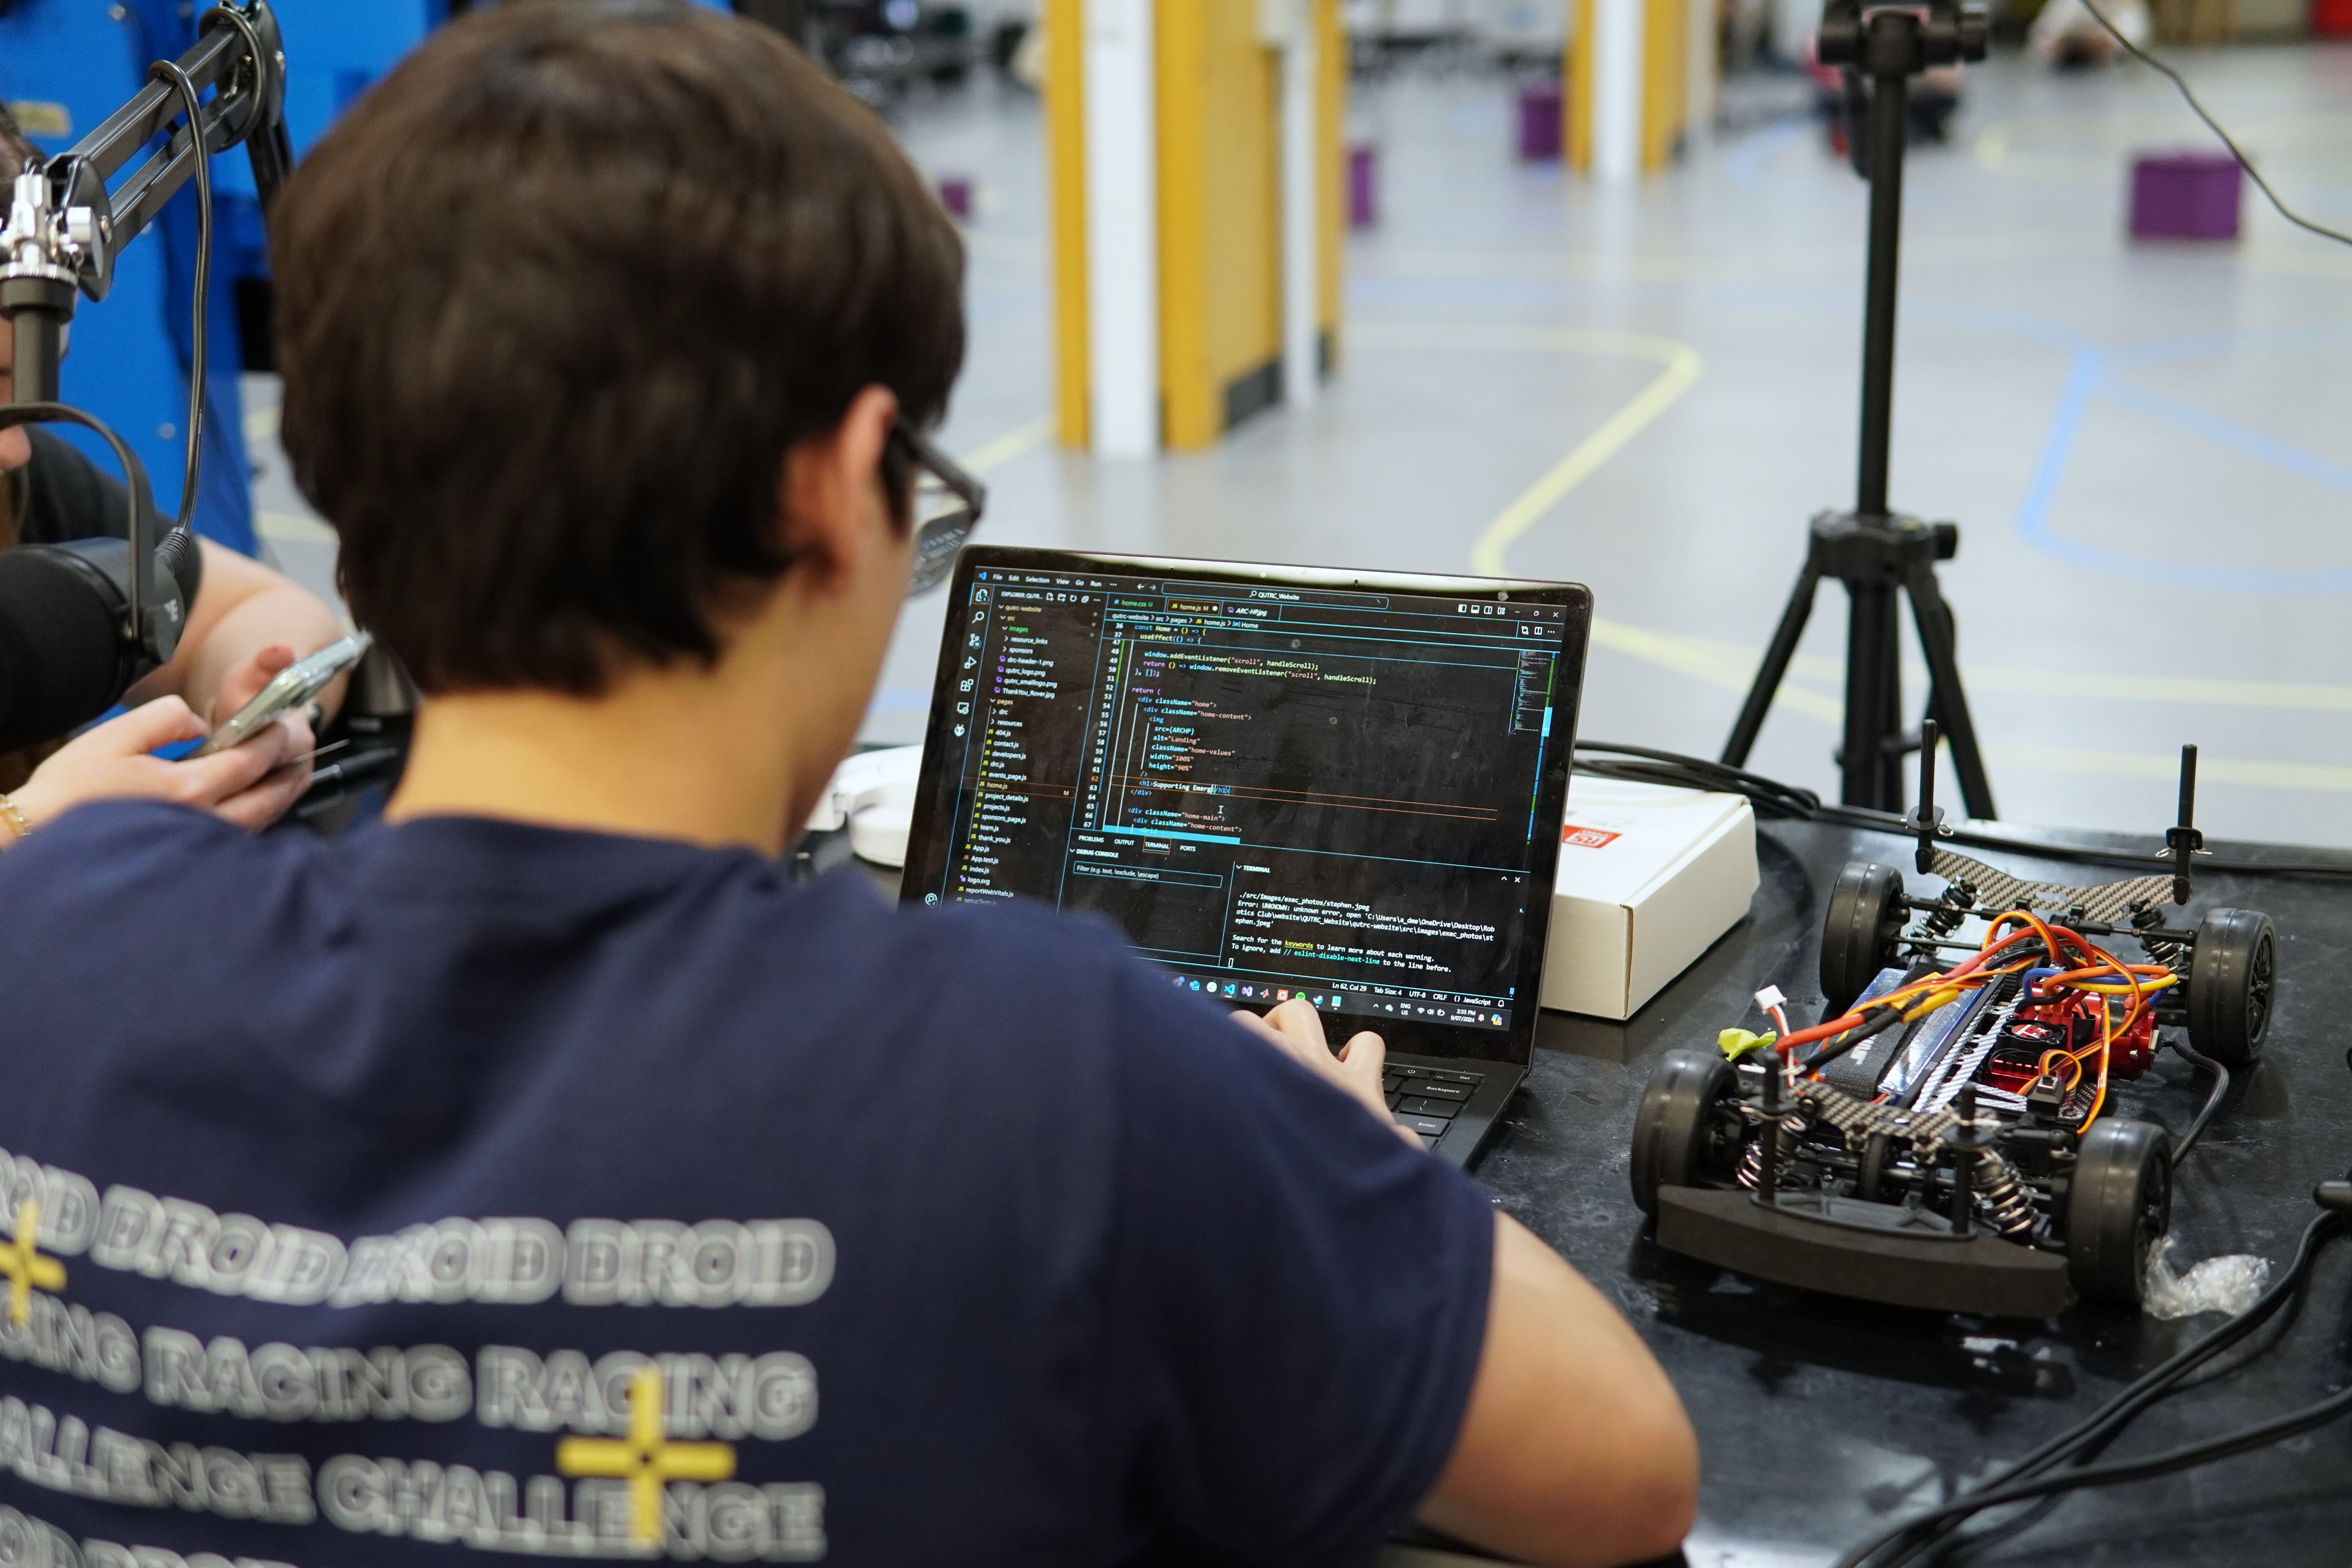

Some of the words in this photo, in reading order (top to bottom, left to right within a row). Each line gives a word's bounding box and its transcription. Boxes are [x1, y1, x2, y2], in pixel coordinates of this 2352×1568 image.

[1258, 592, 1299, 600] QUTRC_Website
[1180, 604, 1201, 612] home.js
[1236, 608, 1267, 617] ARC-HP.jpg
[1007, 657, 1054, 667] drc-header-1.png
[1267, 660, 1318, 670] handleScroll);
[1005, 668, 1045, 677] qutrc_logo.png
[1004, 678, 1057, 688] qutrc_smalllogo.png
[1324, 674, 1376, 684] handleScroll);
[1003, 688, 1055, 699] ThankYou_Rover.jpg
[1154, 726, 1194, 735] src={ARCHP}
[992, 751, 1026, 760] developers.js
[988, 772, 1027, 781] events_page.js
[987, 782, 1007, 790] home.js
[1139, 780, 1190, 791] <h1>Supporting
[1131, 787, 1152, 795] </div>
[985, 793, 1028, 803] project_details.js
[983, 804, 1010, 812] projects.js
[982, 814, 1026, 824] sponsors_page.js
[978, 834, 1011, 844] thank_you.js
[971, 855, 998, 864] App.test.js
[969, 866, 989, 874] index.js
[1114, 869, 1136, 877] !exclude,
[1137, 871, 1159, 879] \escape)
[967, 876, 990, 886] logo.svg
[966, 888, 1014, 898] reportWebVitals.js
[1262, 902, 1290, 911] UNKNOWN:
[1235, 918, 1273, 927] ephen.jpeg'
[1284, 940, 1313, 950] keywords
[1405, 954, 1434, 962] warning.
[1241, 944, 1265, 953] ignore,
[1294, 950, 1380, 964] eslint-disable-next-line
[1426, 964, 1451, 972] before.
[1463, 997, 1491, 1006] JavaScript
[89, 1183, 349, 1306] DROID
[561, 1218, 837, 1308] DROID
[143, 1325, 473, 1423] RACING
[475, 1344, 819, 1442] RACING
[316, 1453, 828, 1560] CHALLENGE
